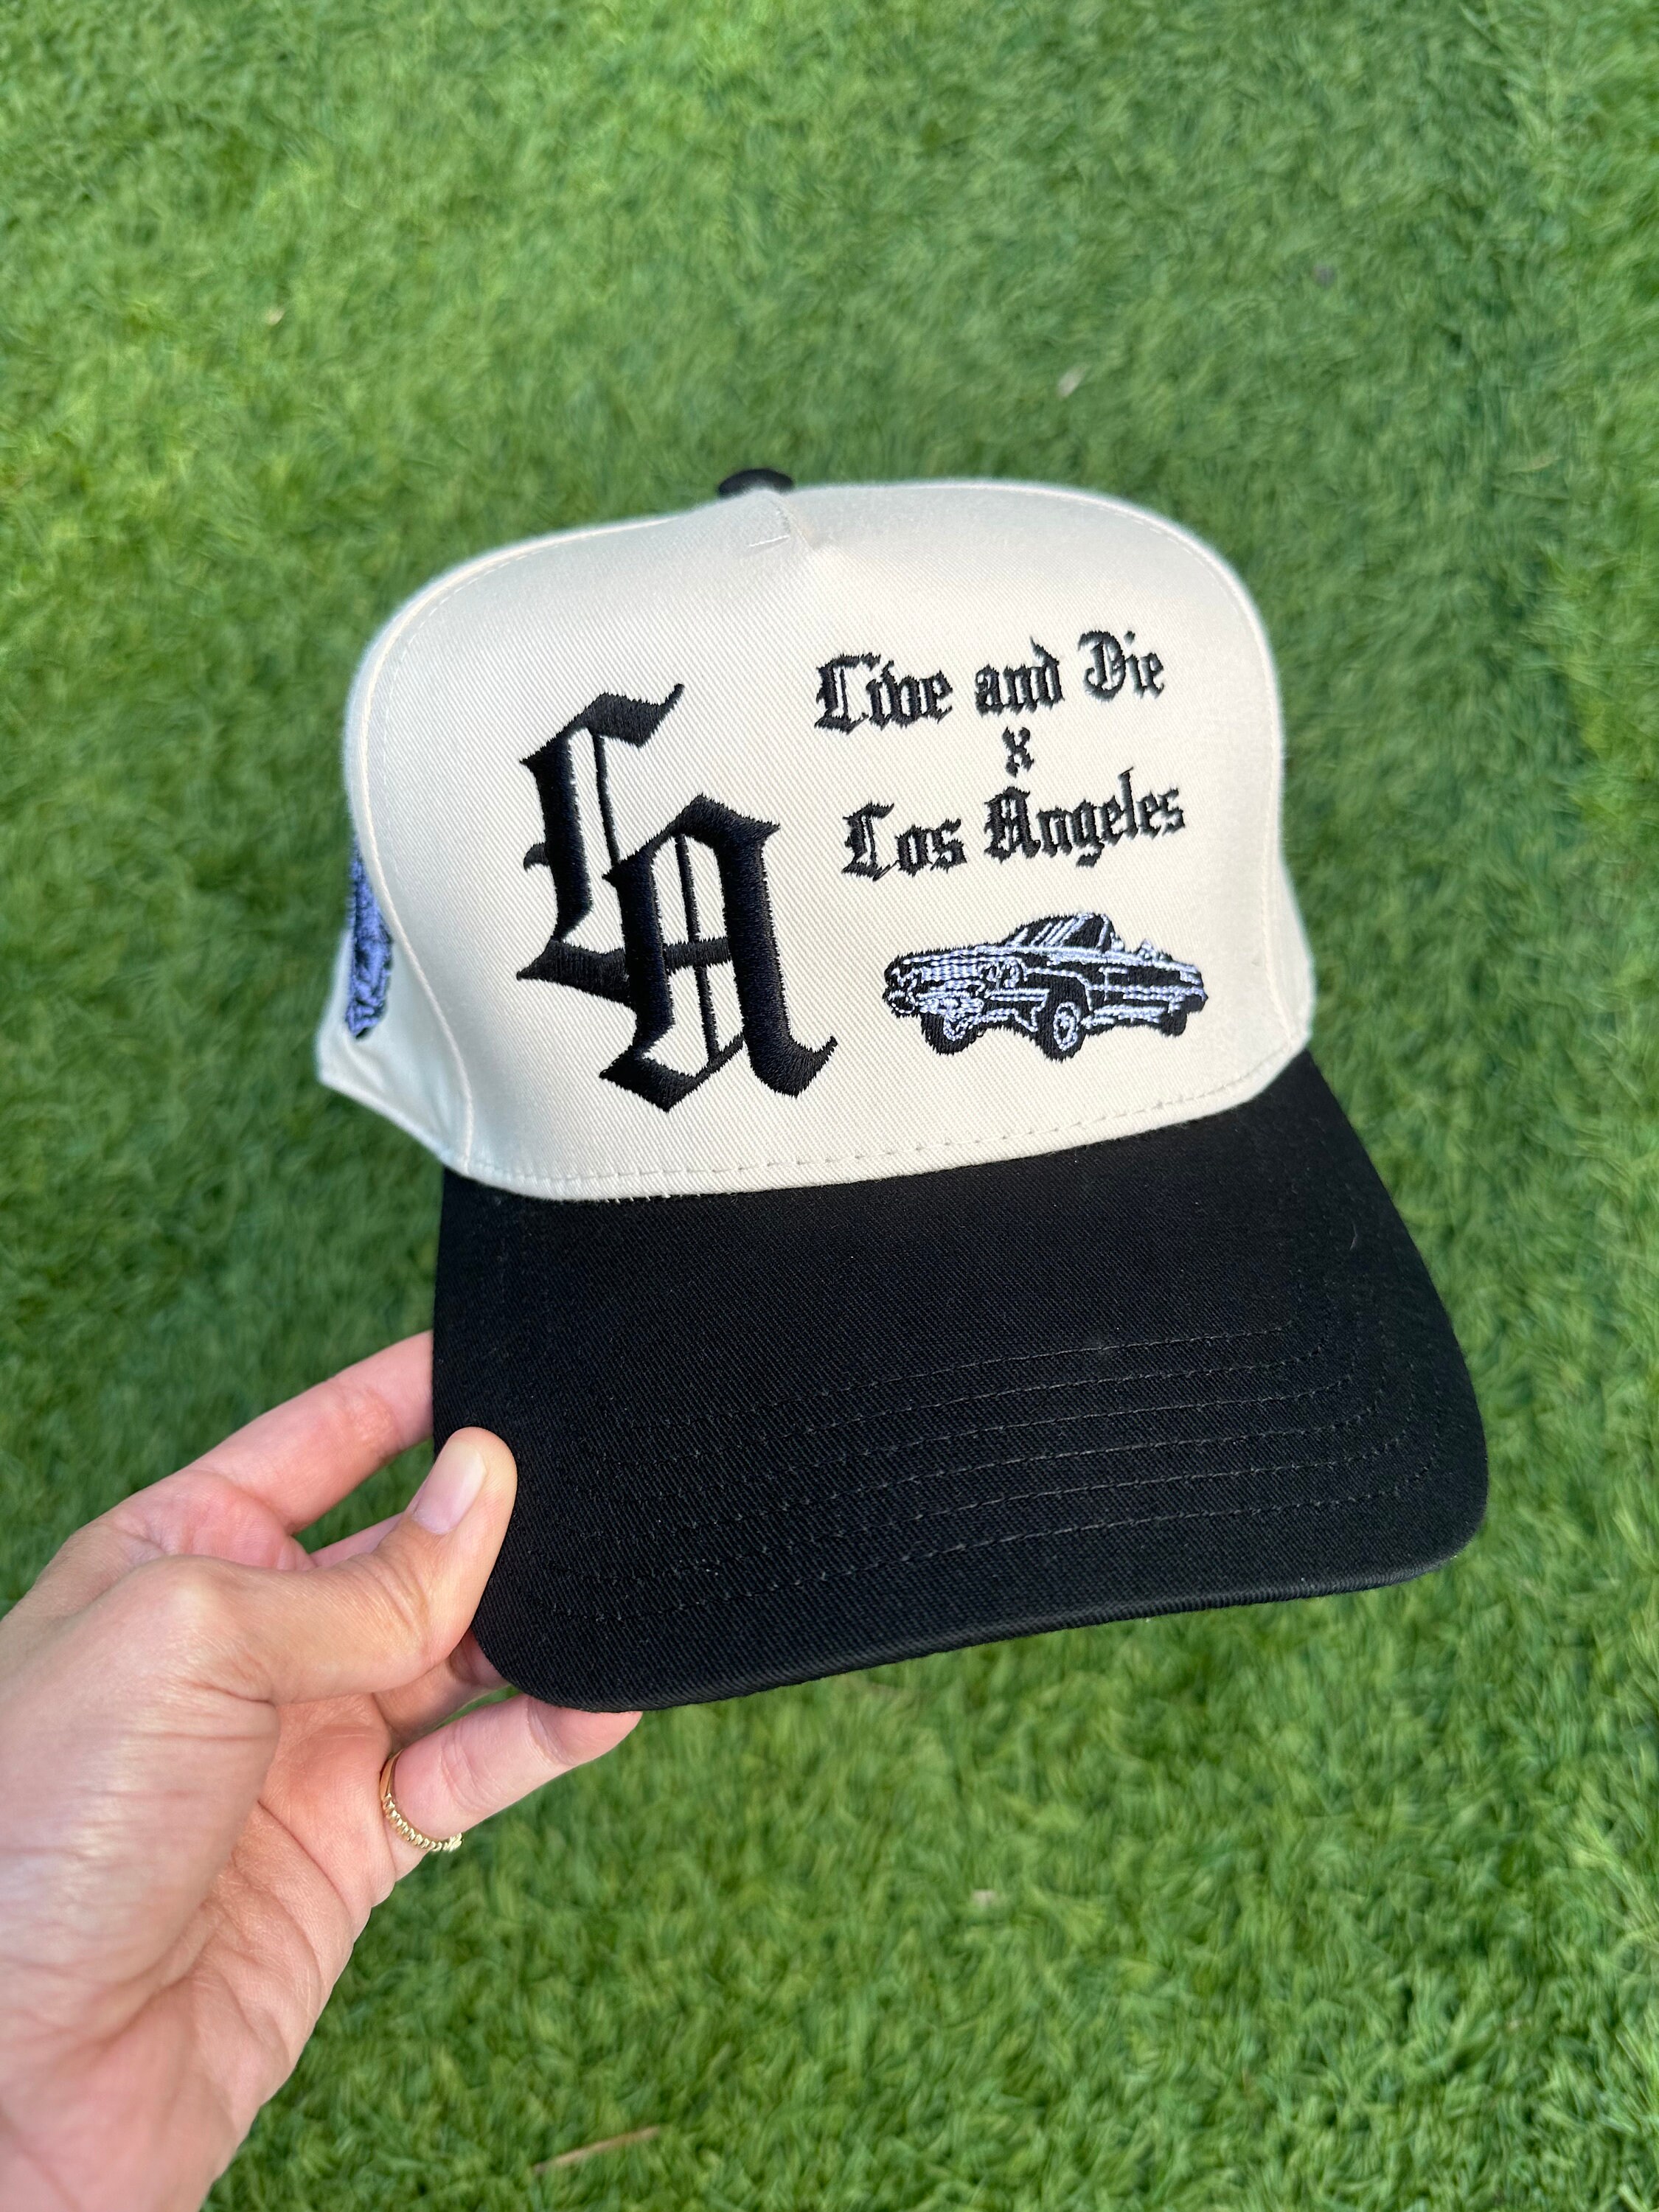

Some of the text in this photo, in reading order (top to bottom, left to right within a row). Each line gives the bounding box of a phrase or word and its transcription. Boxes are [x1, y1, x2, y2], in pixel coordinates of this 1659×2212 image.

[814, 630, 1164, 734] Live and Die
[841, 767, 1186, 881] Los Angeles
[516, 683, 838, 1113] LA
